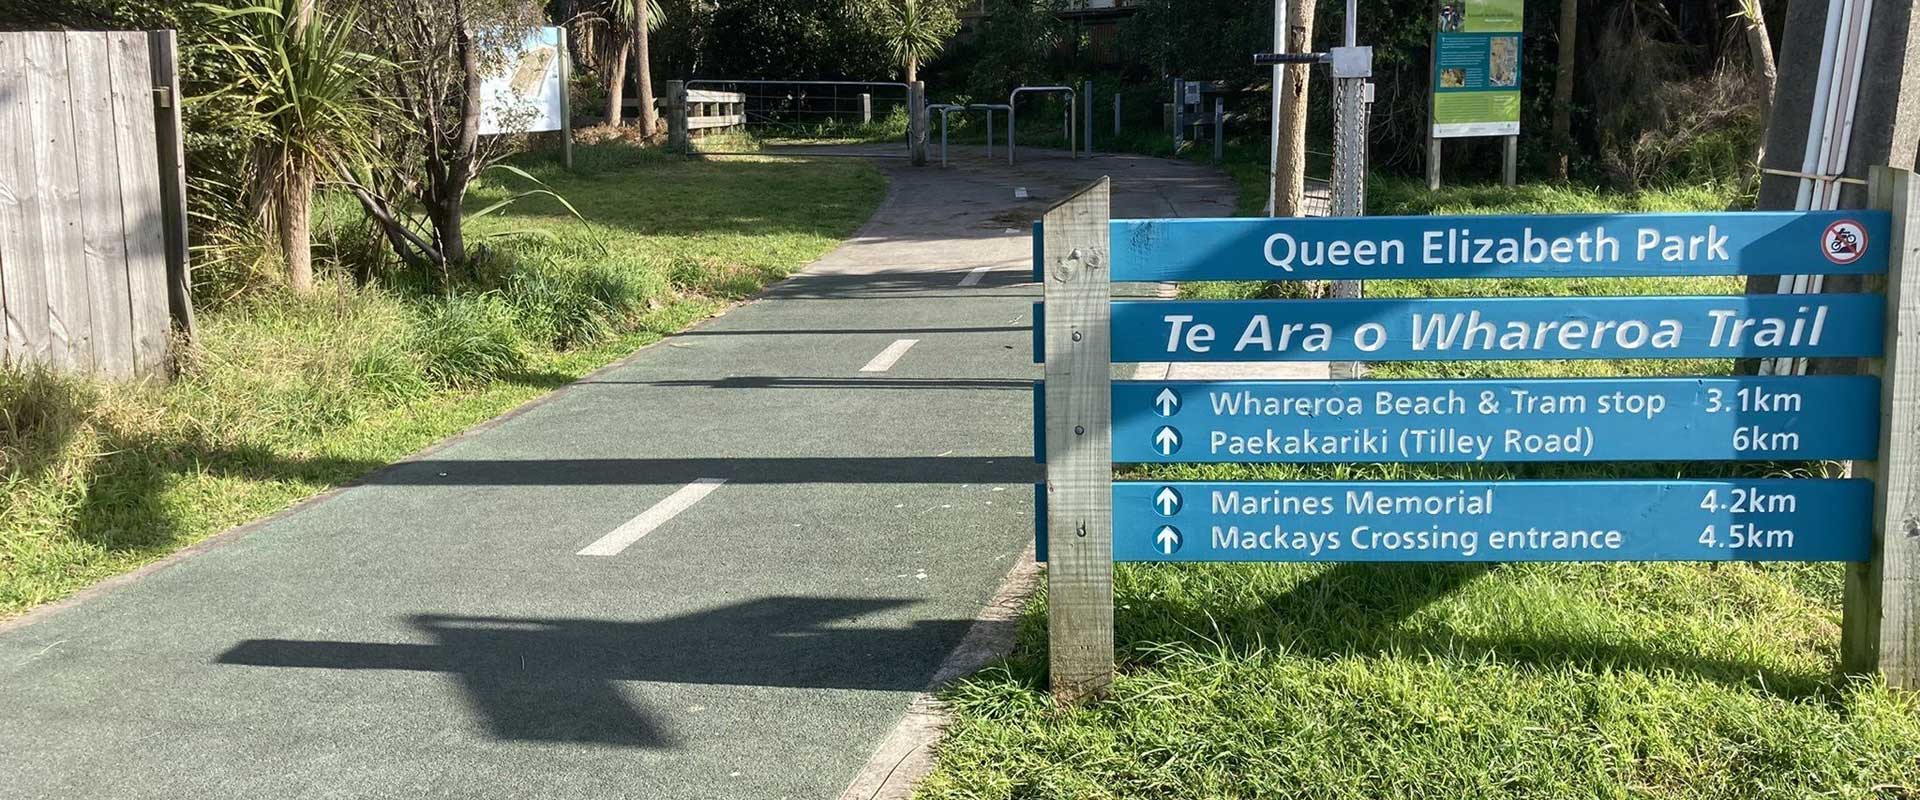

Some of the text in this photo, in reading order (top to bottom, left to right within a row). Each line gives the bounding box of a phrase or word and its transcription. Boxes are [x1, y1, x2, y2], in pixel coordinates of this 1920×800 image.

[1263, 224, 1730, 271] Queen Elizabeth Park
[1163, 305, 1829, 353] Te Ara o Whareroa Trail
[1209, 386, 1802, 420] Whareroa Beach & Tram stop 3.1km
[1209, 425, 1800, 459] Paekakariki (Tilley Road) 6km
[1211, 488, 1797, 516] Marines Memorial 4.2km
[1210, 524, 1795, 557] Mackays Crossing entrance 4.5km
